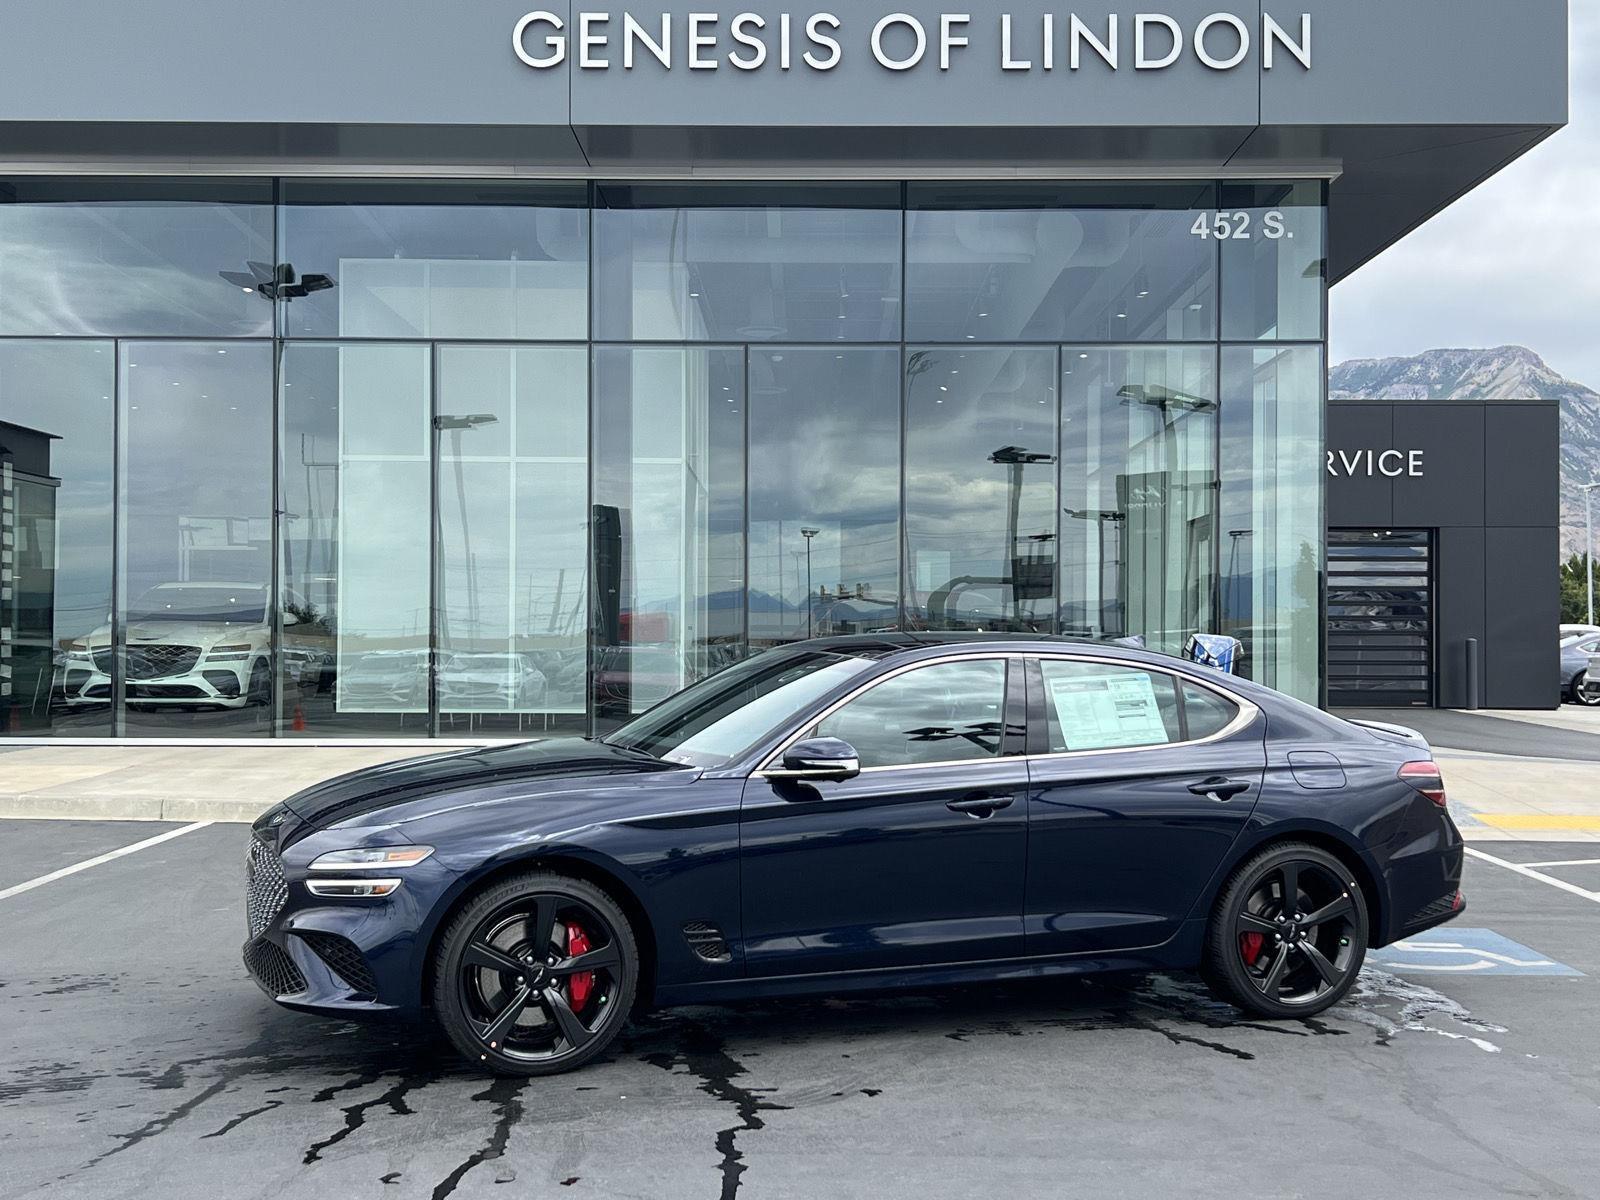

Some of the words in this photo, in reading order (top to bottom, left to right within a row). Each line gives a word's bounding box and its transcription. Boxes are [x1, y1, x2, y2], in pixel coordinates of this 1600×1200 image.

[513, 11, 842, 70] GENESIS
[871, 13, 970, 70] OF
[1002, 12, 1311, 70] LINDON
[1190, 211, 1250, 240] 452
[1263, 210, 1294, 239] S.
